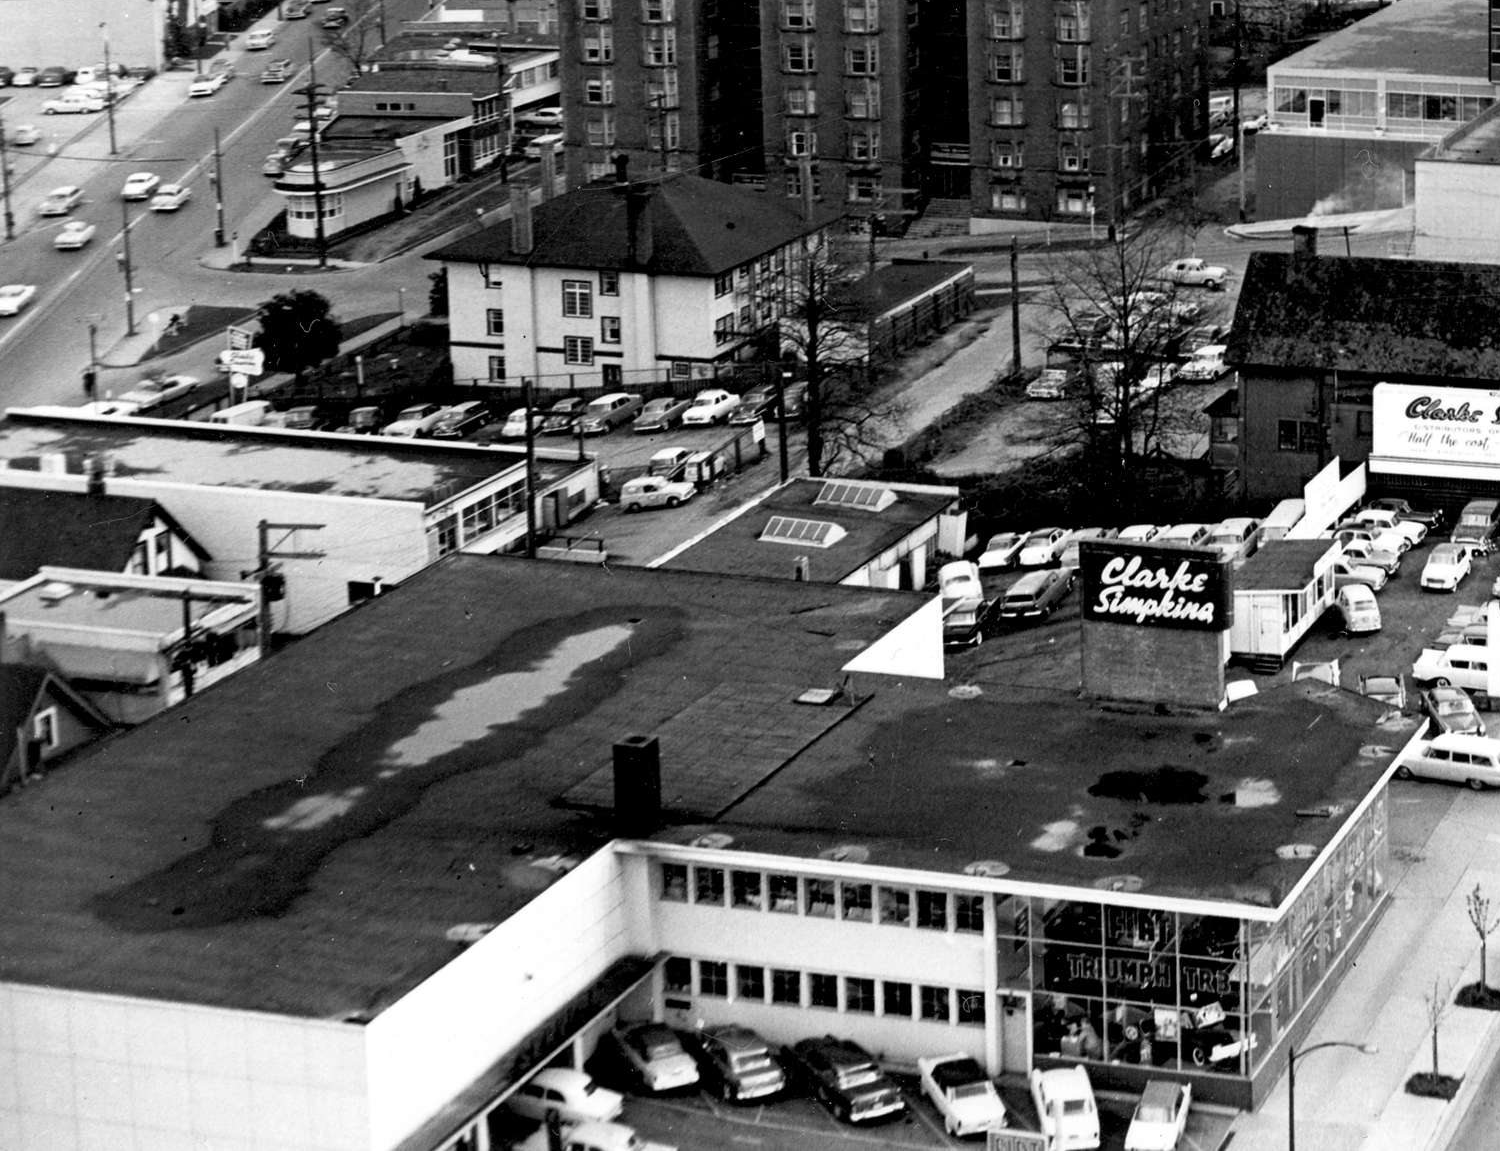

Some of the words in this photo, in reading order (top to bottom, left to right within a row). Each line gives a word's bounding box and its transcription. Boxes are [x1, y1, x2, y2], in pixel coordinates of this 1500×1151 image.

[1405, 395, 1484, 423] Clarke
[1404, 432, 1432, 447] Half
[1440, 433, 1458, 447] the
[1100, 554, 1209, 593] Clarke
[1093, 585, 1215, 624] Simpkins
[1107, 907, 1172, 945] FIAT
[1066, 952, 1172, 988] TRIUMPH
